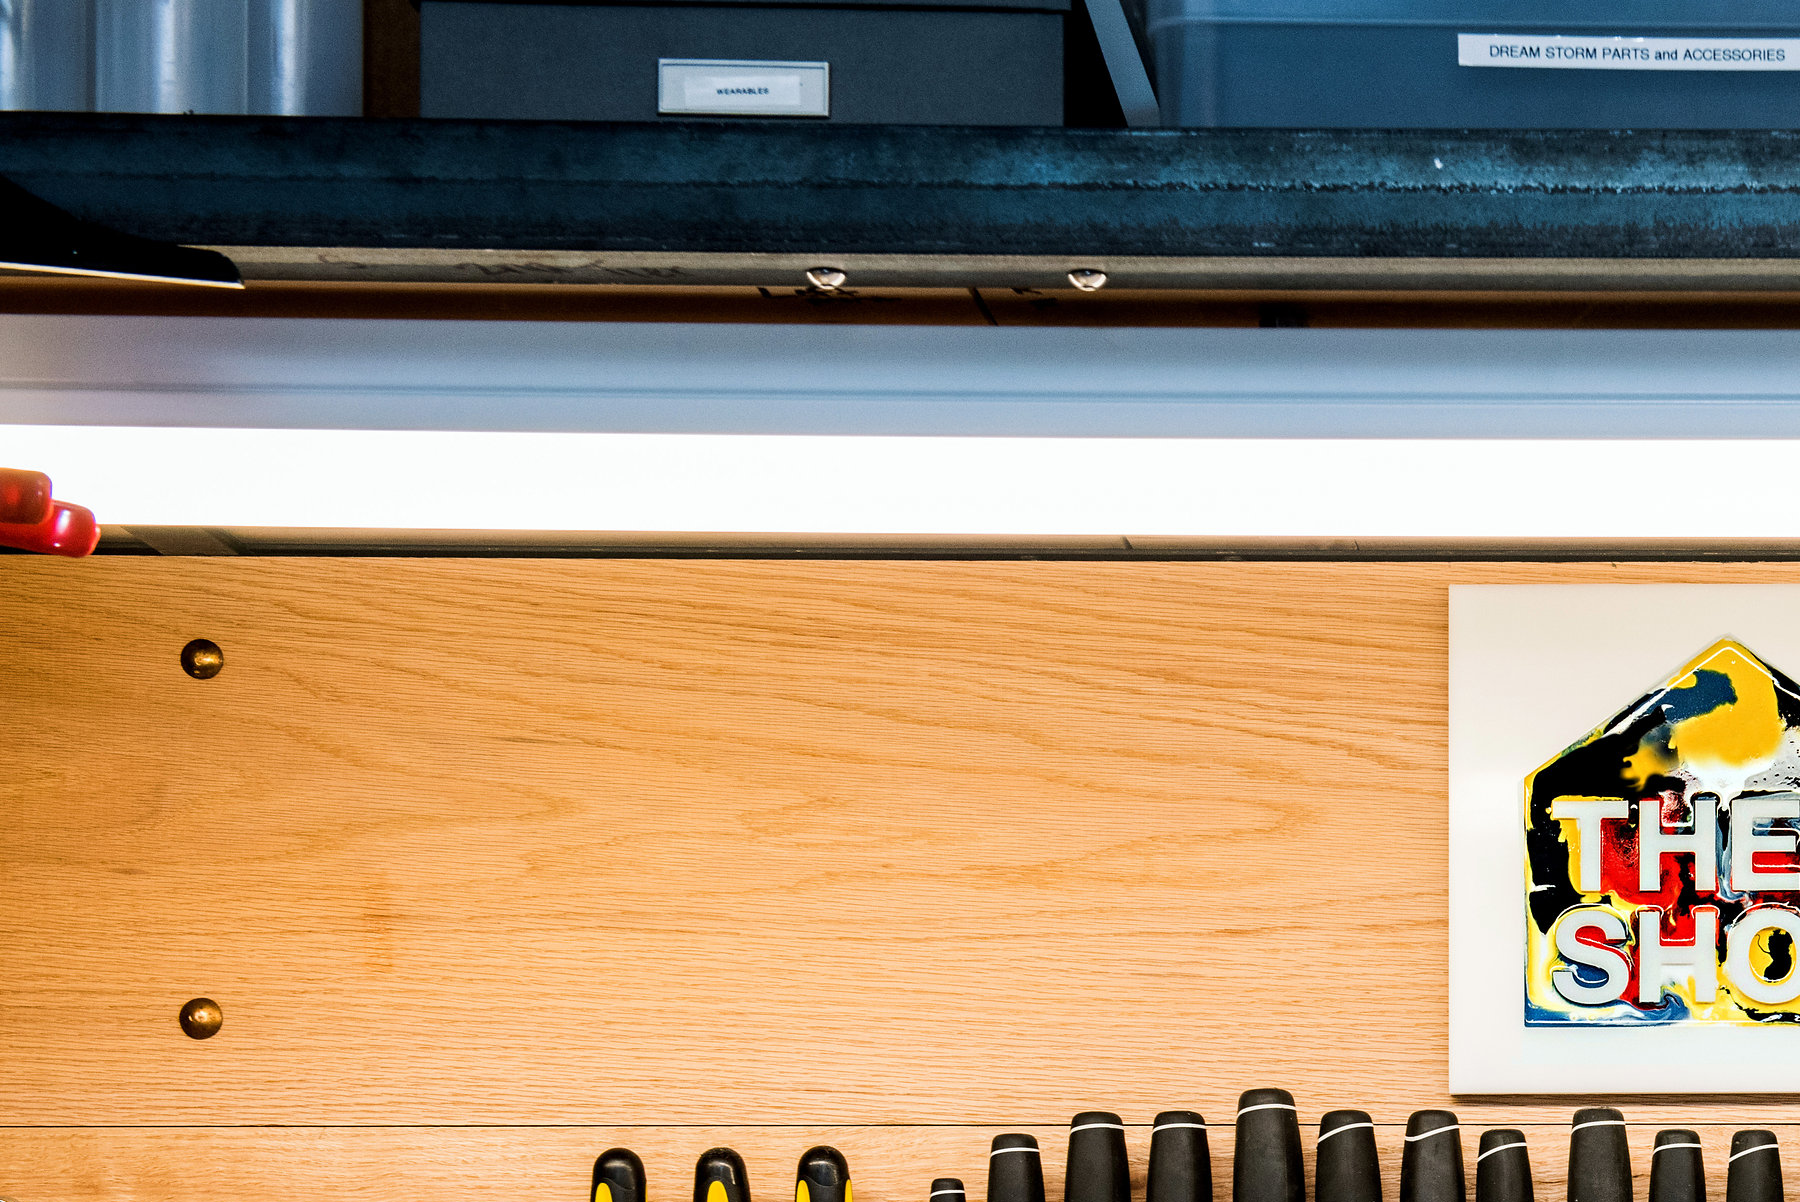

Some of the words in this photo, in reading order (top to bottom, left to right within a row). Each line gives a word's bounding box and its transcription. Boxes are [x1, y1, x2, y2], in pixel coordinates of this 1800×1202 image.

[1489, 44, 1541, 59] DREAM
[1545, 46, 1597, 60] STORM
[1602, 47, 1650, 61] PARTS
[1654, 48, 1678, 61] and
[1683, 48, 1786, 62] ACCESSORIES
[716, 87, 769, 96] WEARABLES
[1551, 799, 1800, 892] THE
